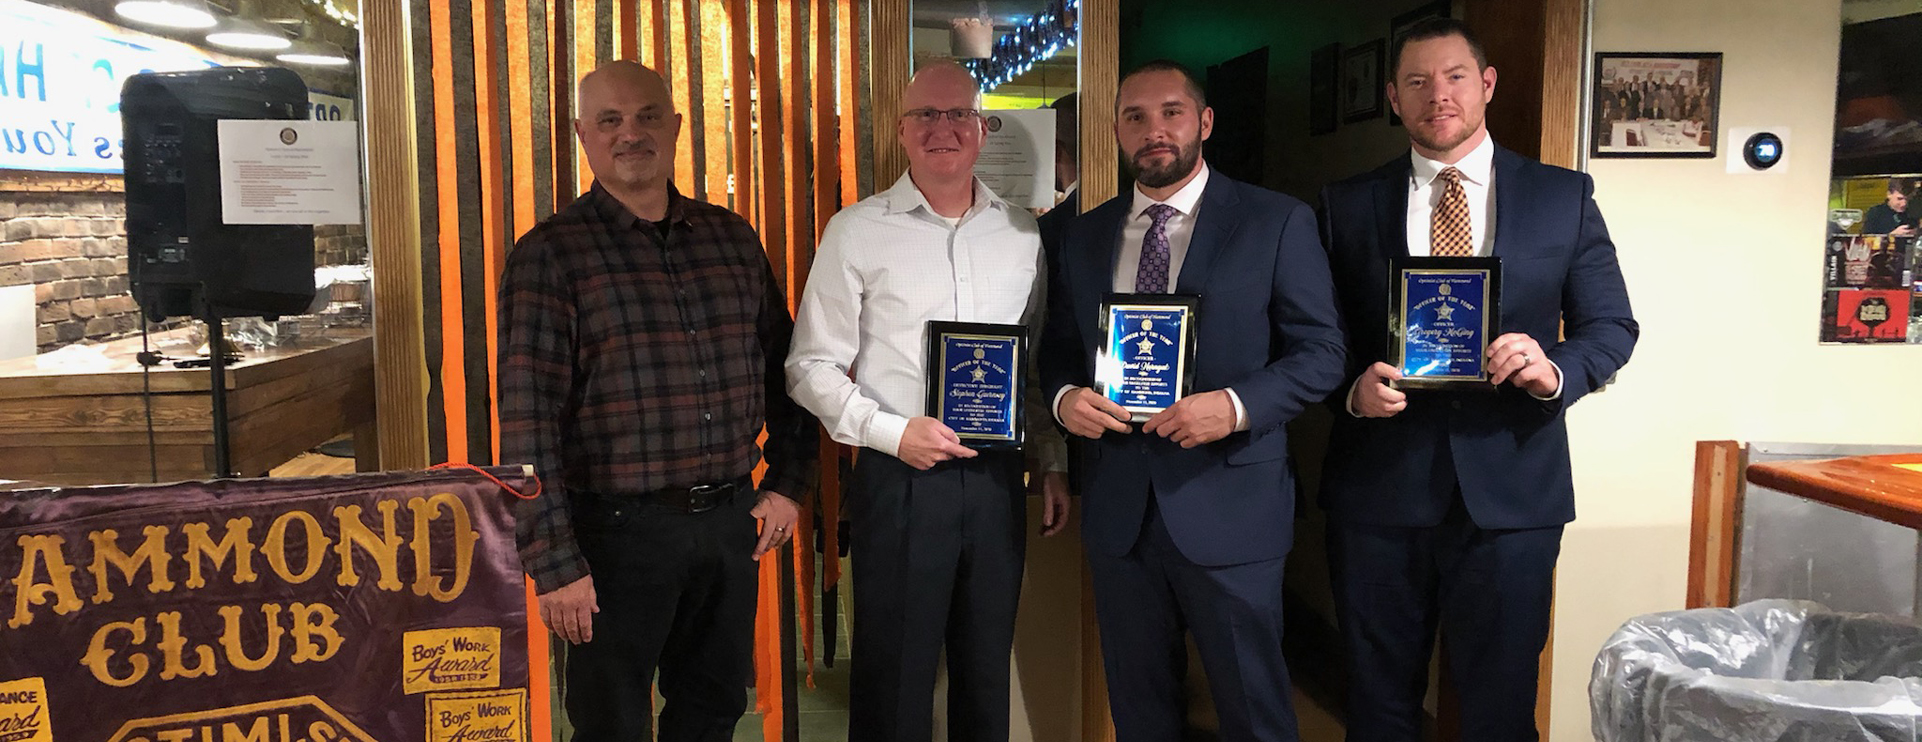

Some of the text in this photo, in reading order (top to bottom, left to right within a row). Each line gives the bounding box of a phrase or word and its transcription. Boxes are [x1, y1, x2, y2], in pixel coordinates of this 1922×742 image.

[1122, 361, 1140, 369] David
[949, 388, 975, 399] Stephen
[80, 602, 346, 687] CLUB
[406, 652, 495, 684] Award
